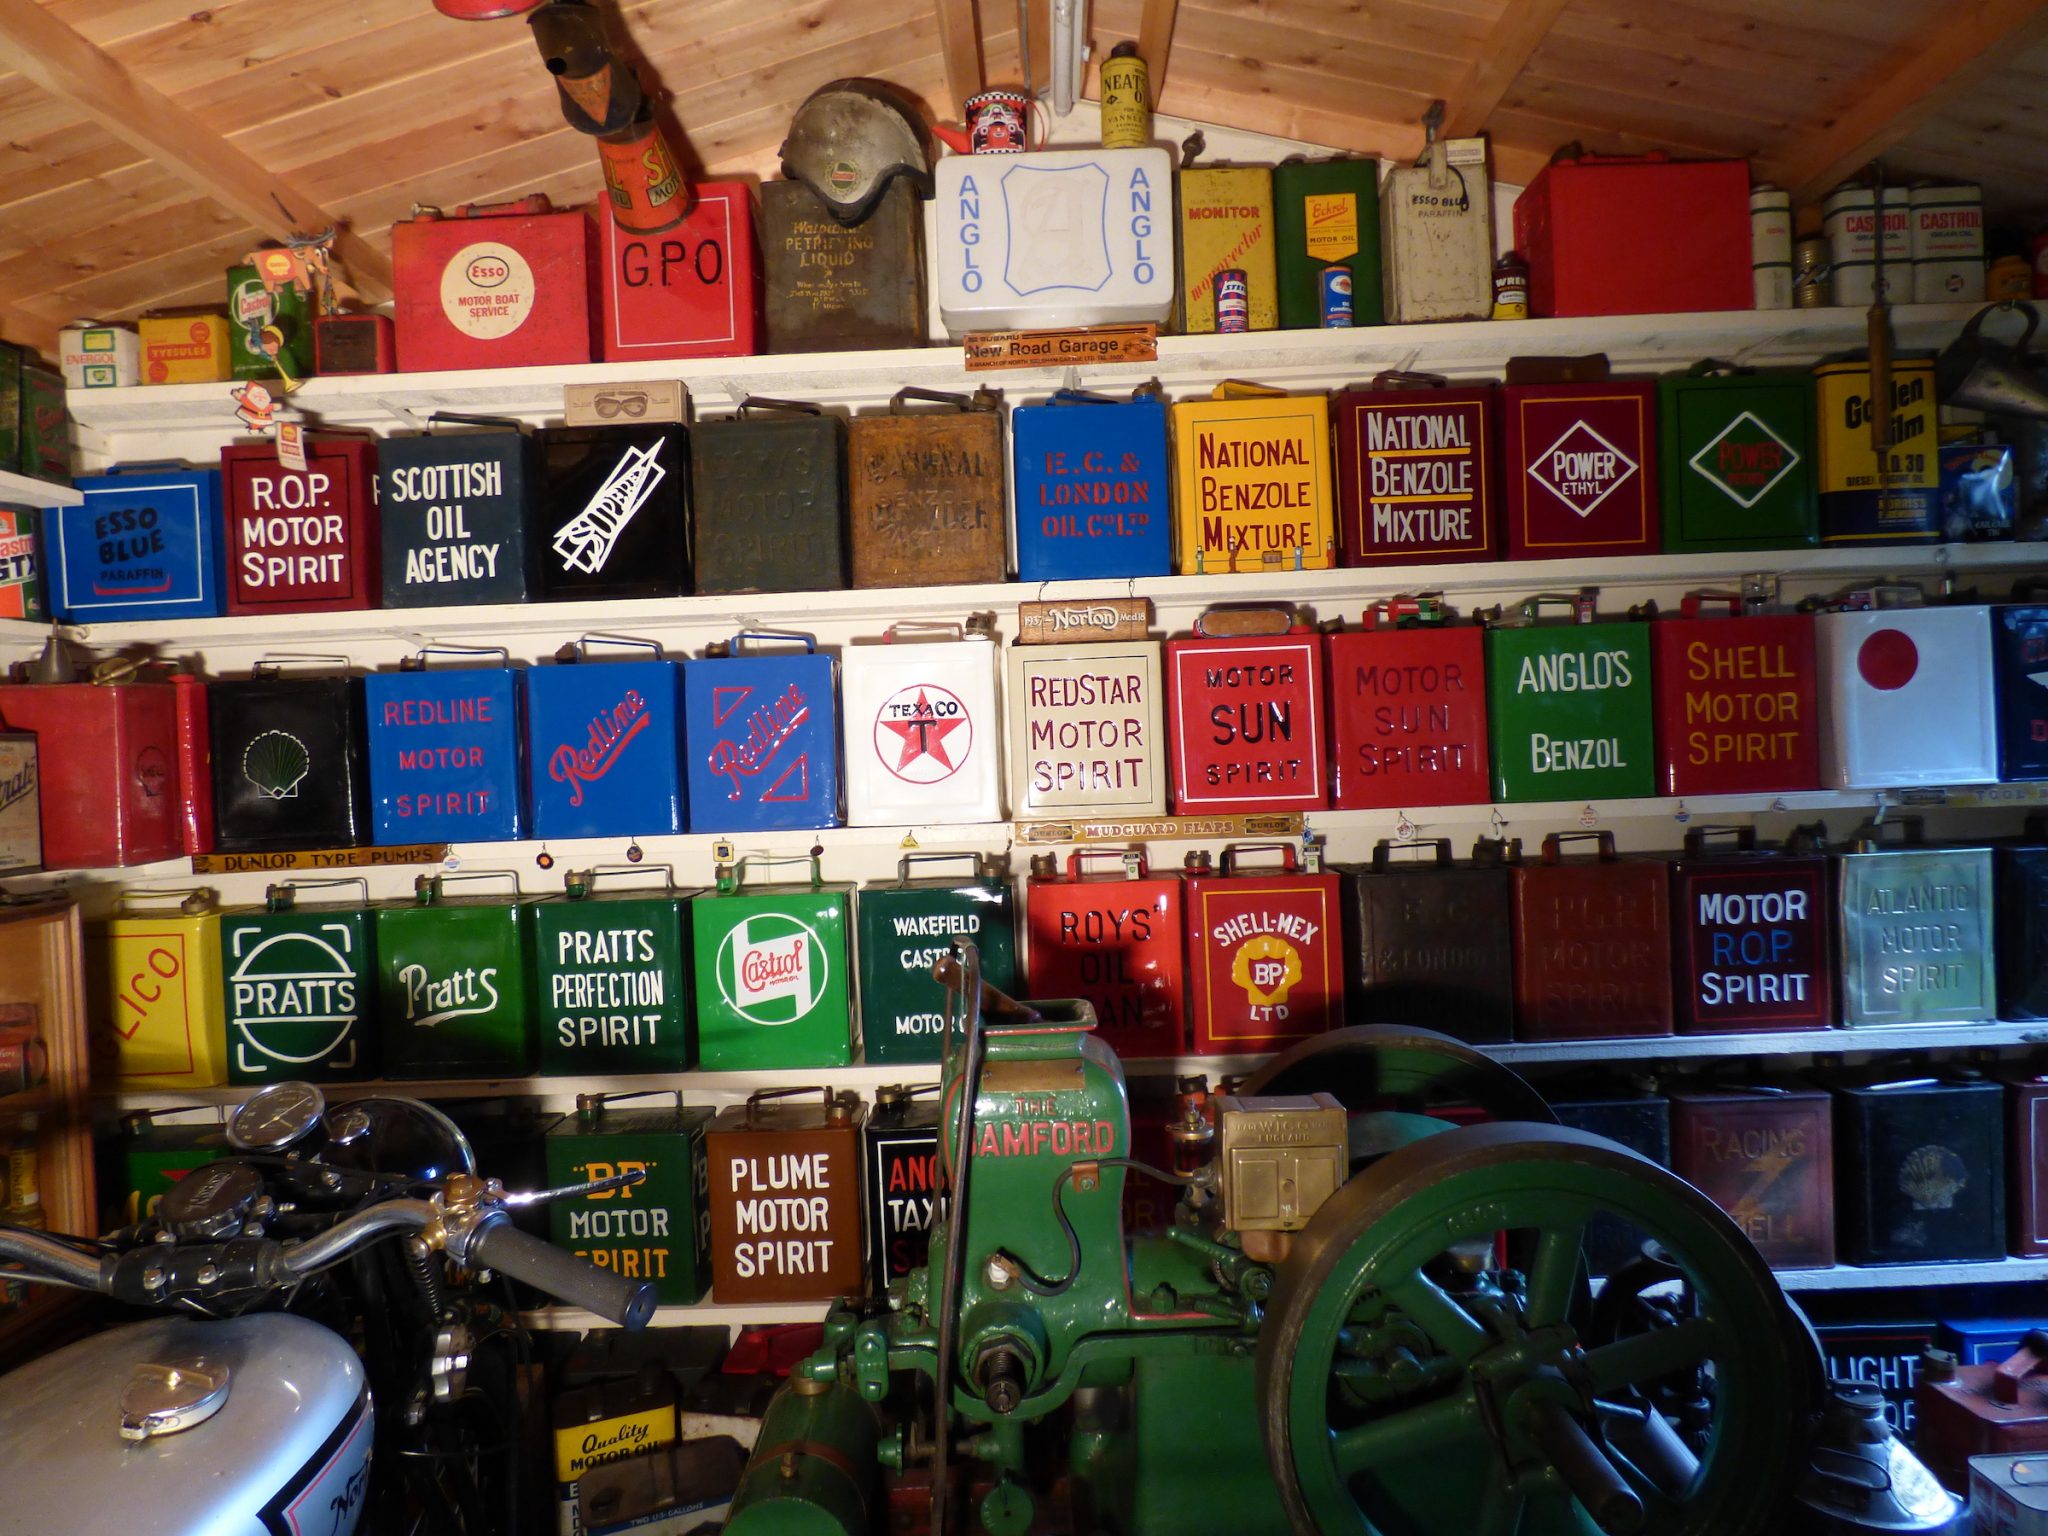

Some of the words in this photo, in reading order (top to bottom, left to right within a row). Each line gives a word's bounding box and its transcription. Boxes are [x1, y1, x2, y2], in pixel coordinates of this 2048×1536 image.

[1188, 206, 1260, 220] MONITOR
[1412, 194, 1438, 206] ESSO
[1442, 197, 1465, 207] BLU
[1418, 210, 1463, 218] PARAFFIN
[959, 175, 983, 293] ANGLO
[1130, 167, 1154, 284] ANGLO
[1846, 213, 1909, 233] CASROL
[1920, 211, 1981, 230] CASTROL
[800, 251, 855, 268] LIQUID
[458, 295, 492, 307] MOTOR
[495, 294, 520, 305] BOAT
[469, 306, 510, 318] SERVICE
[65, 352, 117, 365] ENERGOL
[967, 345, 1002, 359] New
[1010, 340, 1051, 356] Road
[1058, 339, 1119, 354] Garage
[1367, 412, 1471, 451] NATIONAL
[1889, 414, 1924, 446] ilm
[1120, 452, 1140, 473] &
[1200, 433, 1310, 469] NATIONAL
[1553, 450, 1616, 482] POWER
[1718, 439, 1782, 472] POWER
[1905, 454, 1924, 472] 30
[251, 473, 330, 511] R.O.P.
[391, 461, 502, 503] SCOTTISH
[1371, 456, 1474, 496] BENZOLE
[1562, 481, 1603, 496] ETHYL
[1040, 482, 1149, 506] LONDON
[1202, 476, 1311, 512] BENZOLE
[95, 507, 158, 539] ESSO
[243, 515, 344, 548] MOTOR
[427, 505, 471, 541] OIL
[1042, 515, 1083, 538] OIL
[1203, 516, 1312, 552] MIXTURE
[1373, 503, 1472, 543] MIXTURE
[98, 530, 165, 565] BLUE
[100, 567, 164, 582] PARAFFIN
[243, 552, 344, 587] SPIRIT
[405, 544, 500, 584] AGENCY
[1049, 606, 1119, 632] Norton
[1206, 664, 1294, 688] MOTOR
[1687, 641, 1796, 681] SHELL
[1356, 663, 1465, 697] MOTOR
[385, 697, 494, 727] REDLINE
[889, 701, 959, 718] TEXACO
[1211, 700, 1293, 746] SUN
[1375, 704, 1449, 736] SUN
[1686, 691, 1799, 724] MOTOR
[549, 689, 648, 808] Redline
[708, 683, 808, 801] Redline
[908, 719, 937, 754] T
[1031, 718, 1144, 750] MOTOR
[1688, 732, 1799, 765] SPIRIT
[399, 747, 484, 770] MOTOR
[1359, 743, 1468, 776] SPIRIT
[1530, 733, 1627, 773] BENZOL
[1034, 758, 1144, 792] SPIRIT
[1206, 759, 1301, 786] SPIRIT
[397, 791, 490, 818] SPIRIT
[1086, 823, 1178, 839] MUDGUARD
[1184, 820, 1234, 834] FLAPS
[1251, 820, 1287, 830] DUNLOP
[224, 853, 297, 871] DUNLOP
[311, 853, 357, 866] TYRE
[372, 849, 433, 864] PUMPS
[1700, 890, 1808, 925] MOTOR
[1867, 884, 1969, 915] ATLANTIC
[893, 914, 981, 936] WAKEFIELD
[1213, 911, 1319, 948] SHELL-MEX
[1881, 924, 1963, 954] MOTOR
[558, 929, 655, 965] PRATTS
[1713, 929, 1793, 967] R.O.P.
[742, 939, 803, 993] Castrol
[1080, 952, 1135, 985] OIL
[1254, 962, 1284, 986] BP
[1882, 963, 1964, 994] SPIRIT
[234, 980, 356, 1016] PRATTS
[552, 970, 664, 1009] PERFECTION
[1702, 972, 1810, 1005] SPIRIT
[1096, 996, 1144, 1028] AN
[1250, 1004, 1290, 1022] LTD
[557, 1015, 662, 1047] SPIRIT
[1015, 1097, 1057, 1116] THE
[1702, 1125, 1808, 1163] RACING
[730, 1153, 830, 1193] PLUME
[569, 1208, 670, 1240] MOTOR
[736, 1196, 829, 1235] MOTOR
[573, 1247, 670, 1279] PIRIT
[734, 1240, 835, 1279] SPIRIT
[582, 1423, 650, 1454] Quality
[631, 1516, 650, 1527] TWO
[668, 1502, 704, 1518] GALLONS
